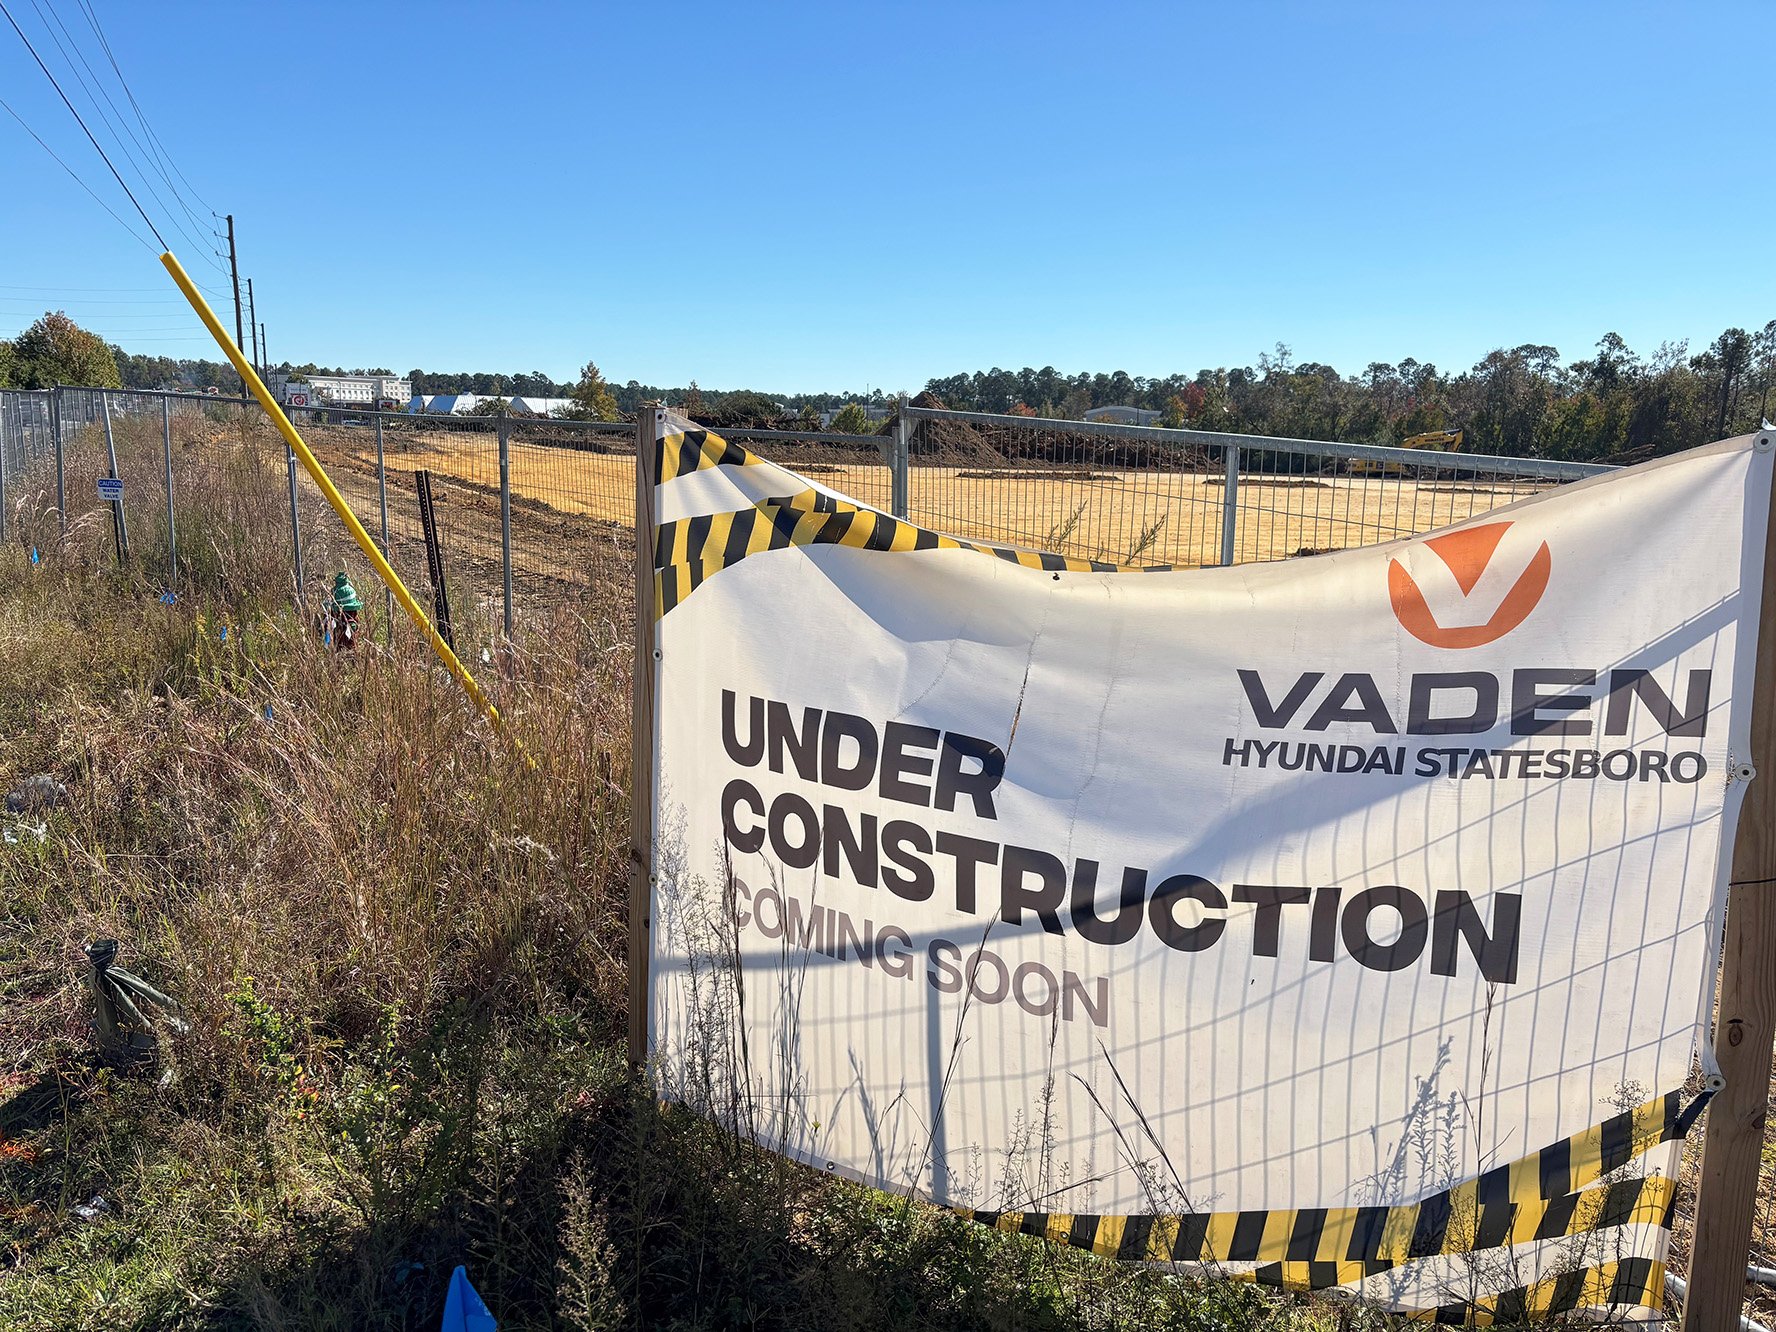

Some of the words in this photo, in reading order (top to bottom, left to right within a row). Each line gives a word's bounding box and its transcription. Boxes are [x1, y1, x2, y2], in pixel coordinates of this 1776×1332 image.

[721, 688, 1006, 820] UNDER
[1222, 738, 1407, 775] HYUNDAI
[1415, 747, 1708, 784] STATESBORO
[1236, 668, 1712, 738] VADEN
[721, 778, 1522, 984] CONSTRUCTION
[729, 877, 914, 981] COMING
[927, 938, 1109, 1028] SOON
